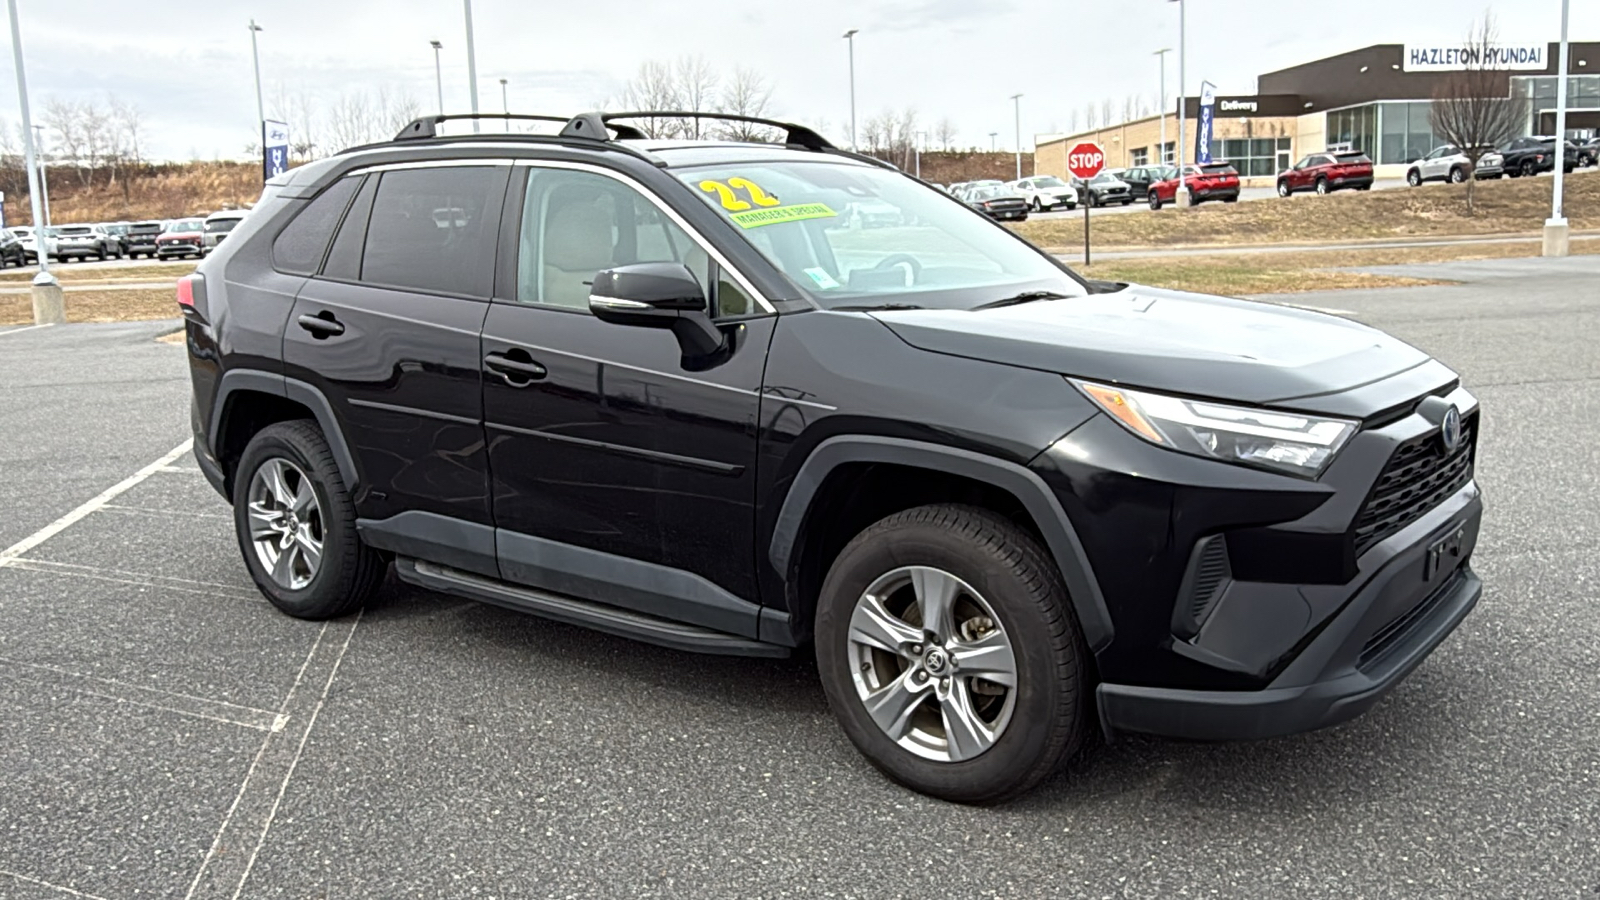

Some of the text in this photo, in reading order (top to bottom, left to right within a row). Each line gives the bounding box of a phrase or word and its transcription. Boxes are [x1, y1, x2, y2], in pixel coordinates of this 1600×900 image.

[1411, 47, 1541, 65] HAZLETON HYUNDAI
[1221, 101, 1257, 112] Delivery
[1070, 153, 1103, 169] STOP
[699, 177, 780, 211] 22
[736, 204, 828, 224] MANAGER'S SPECIAL
